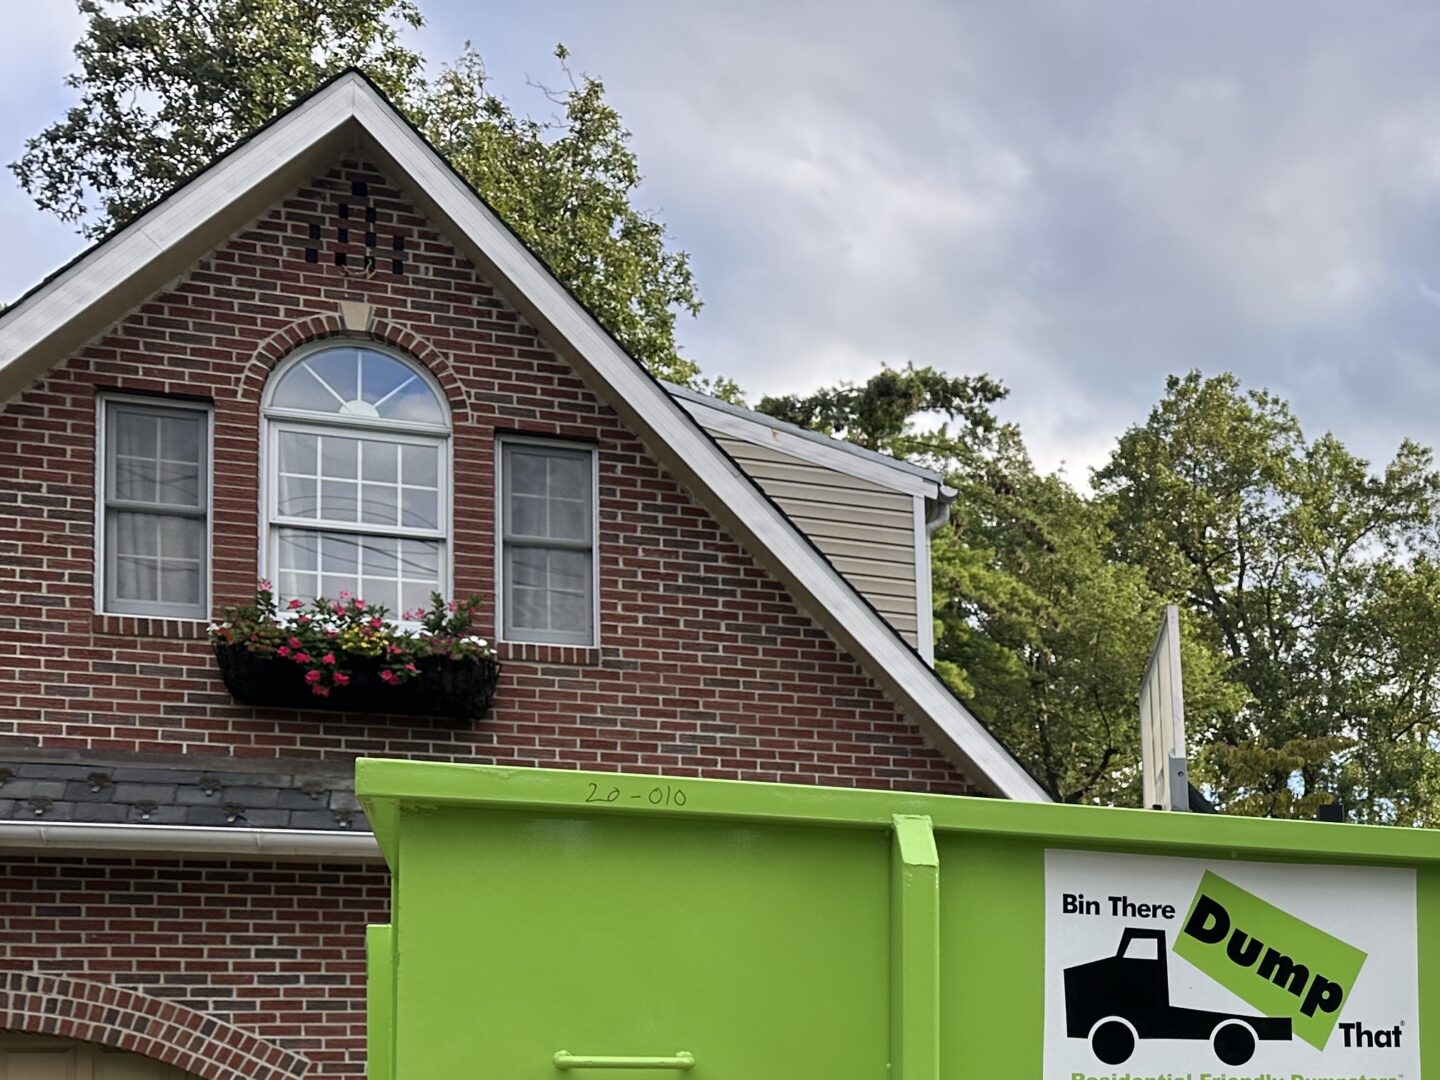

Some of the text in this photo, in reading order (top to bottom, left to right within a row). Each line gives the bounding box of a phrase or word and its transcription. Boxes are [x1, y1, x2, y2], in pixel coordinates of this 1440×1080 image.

[1062, 893, 1176, 920] Bin There
[1183, 893, 1343, 1018] Dump
[1338, 1021, 1403, 1048] That
